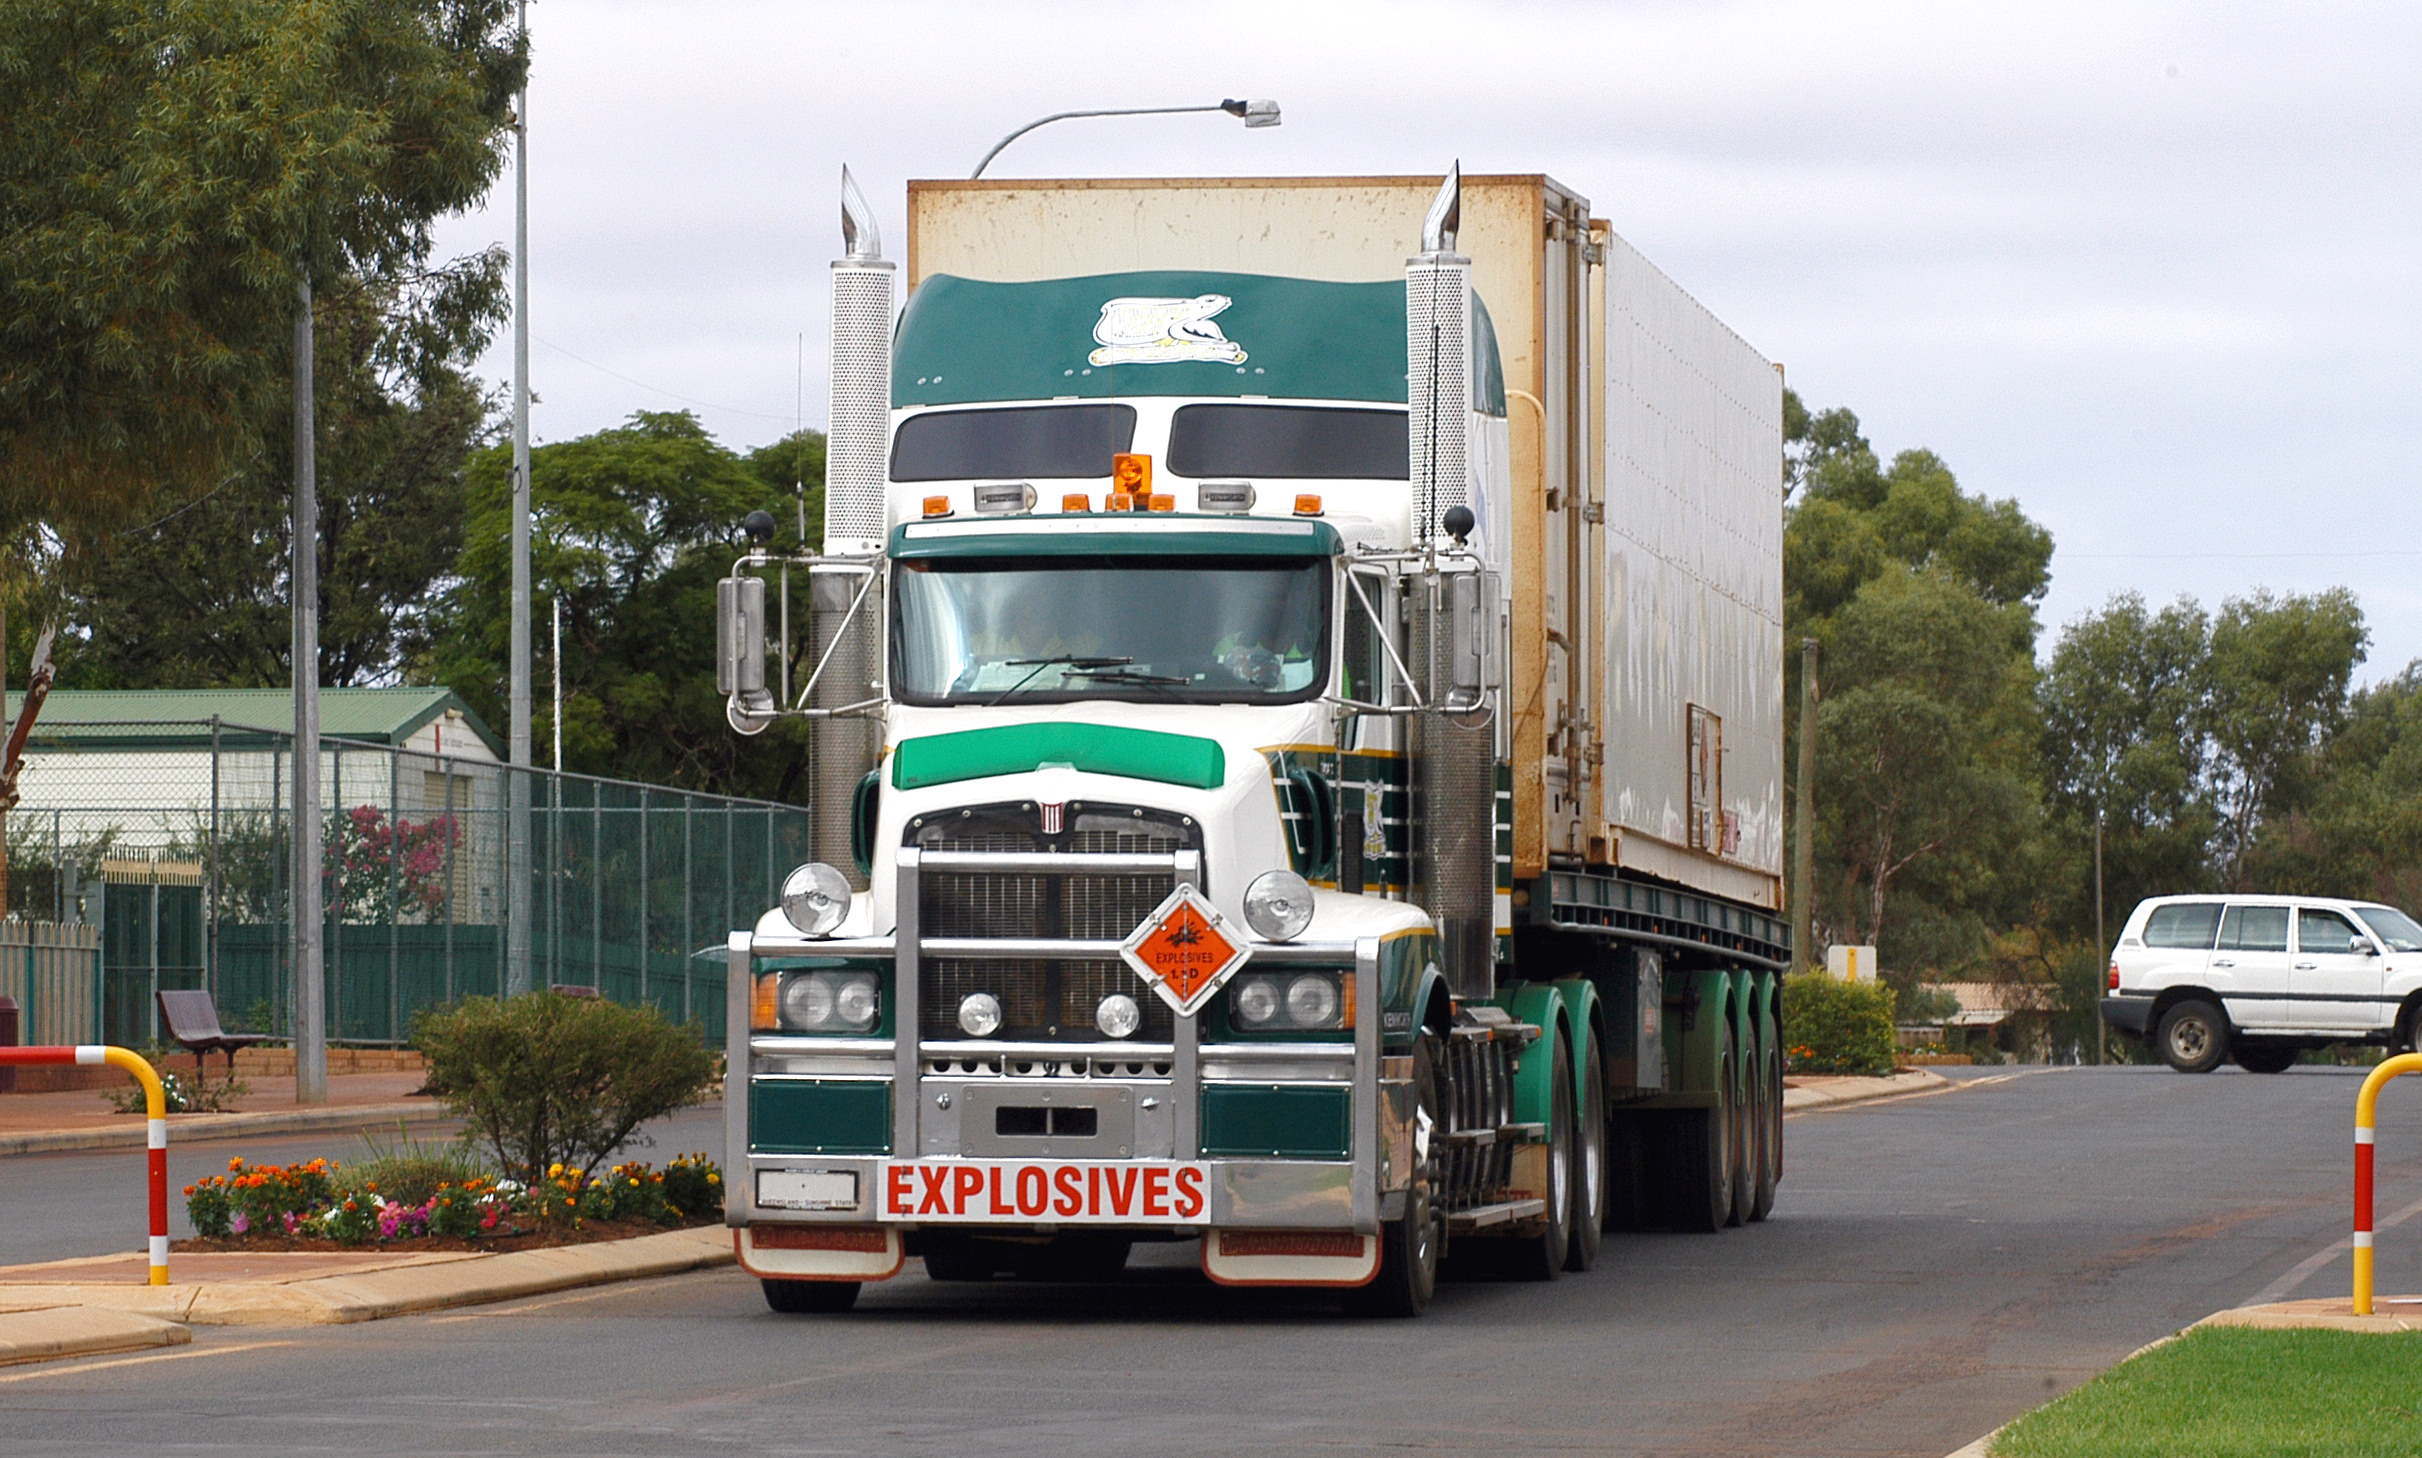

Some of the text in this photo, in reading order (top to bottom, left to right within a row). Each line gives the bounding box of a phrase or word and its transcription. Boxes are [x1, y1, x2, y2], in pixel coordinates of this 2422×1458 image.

[1156, 952, 1214, 964] EXPLOSIVES
[1171, 968, 1199, 979] 1.D
[887, 1165, 1204, 1218] EXPLOSIVES
